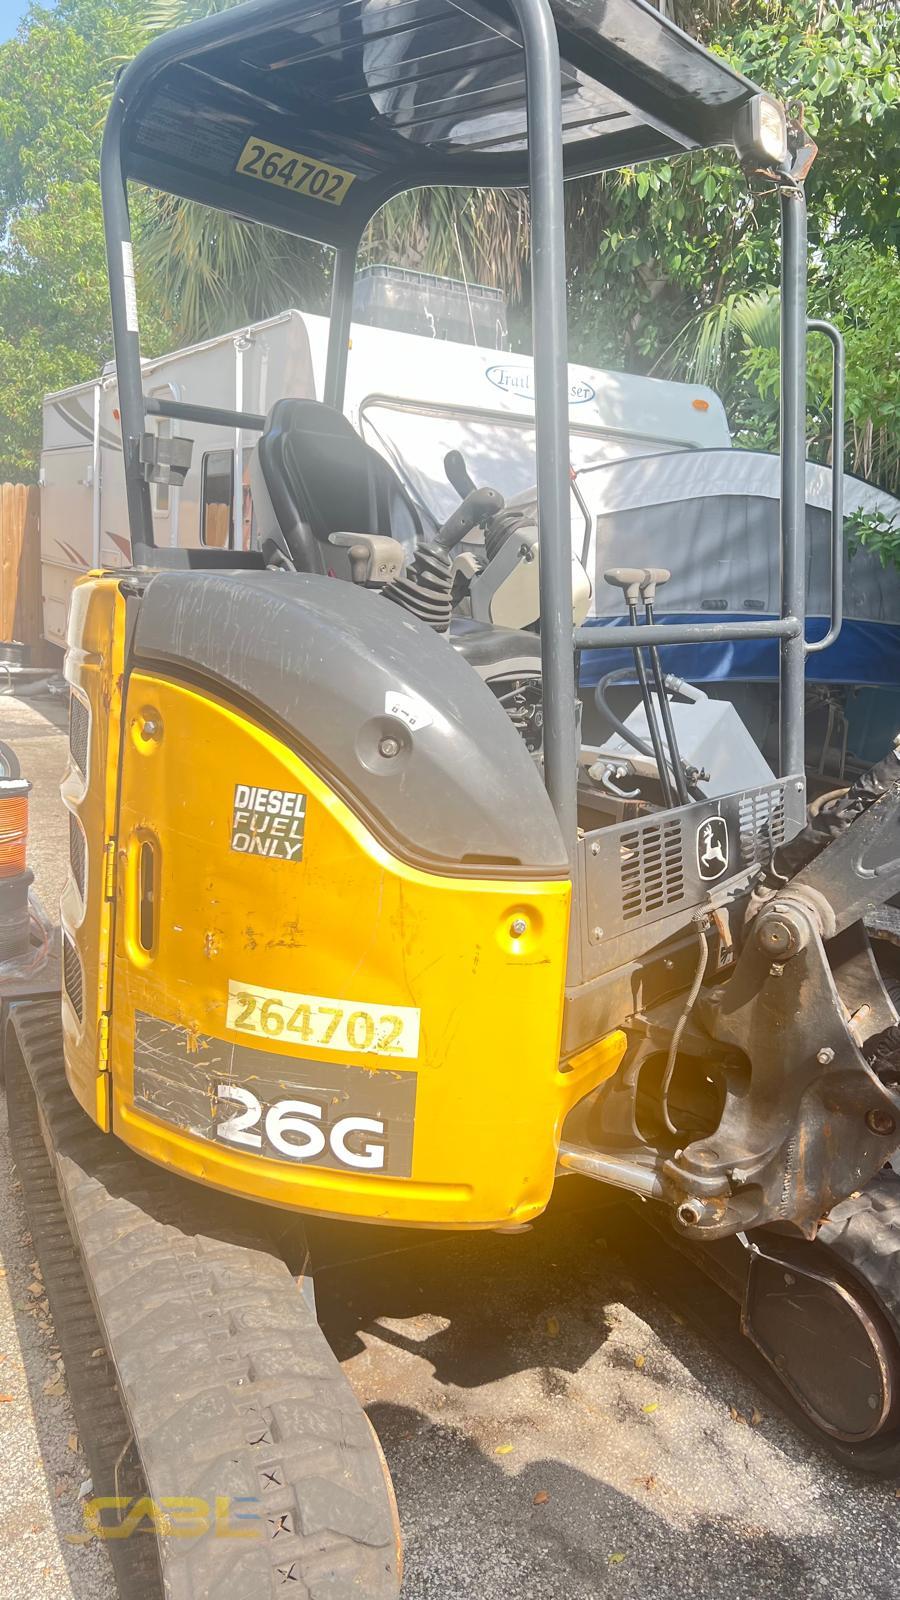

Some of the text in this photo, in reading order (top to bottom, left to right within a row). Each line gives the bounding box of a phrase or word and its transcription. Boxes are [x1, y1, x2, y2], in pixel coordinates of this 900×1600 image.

[243, 145, 344, 200] 264702
[493, 368, 530, 389] Trail
[235, 785, 305, 818] DIESEL
[234, 811, 304, 839] FUEL
[232, 833, 303, 860] ONLY
[234, 991, 404, 1052] 264702
[217, 1084, 384, 1168] 26G
